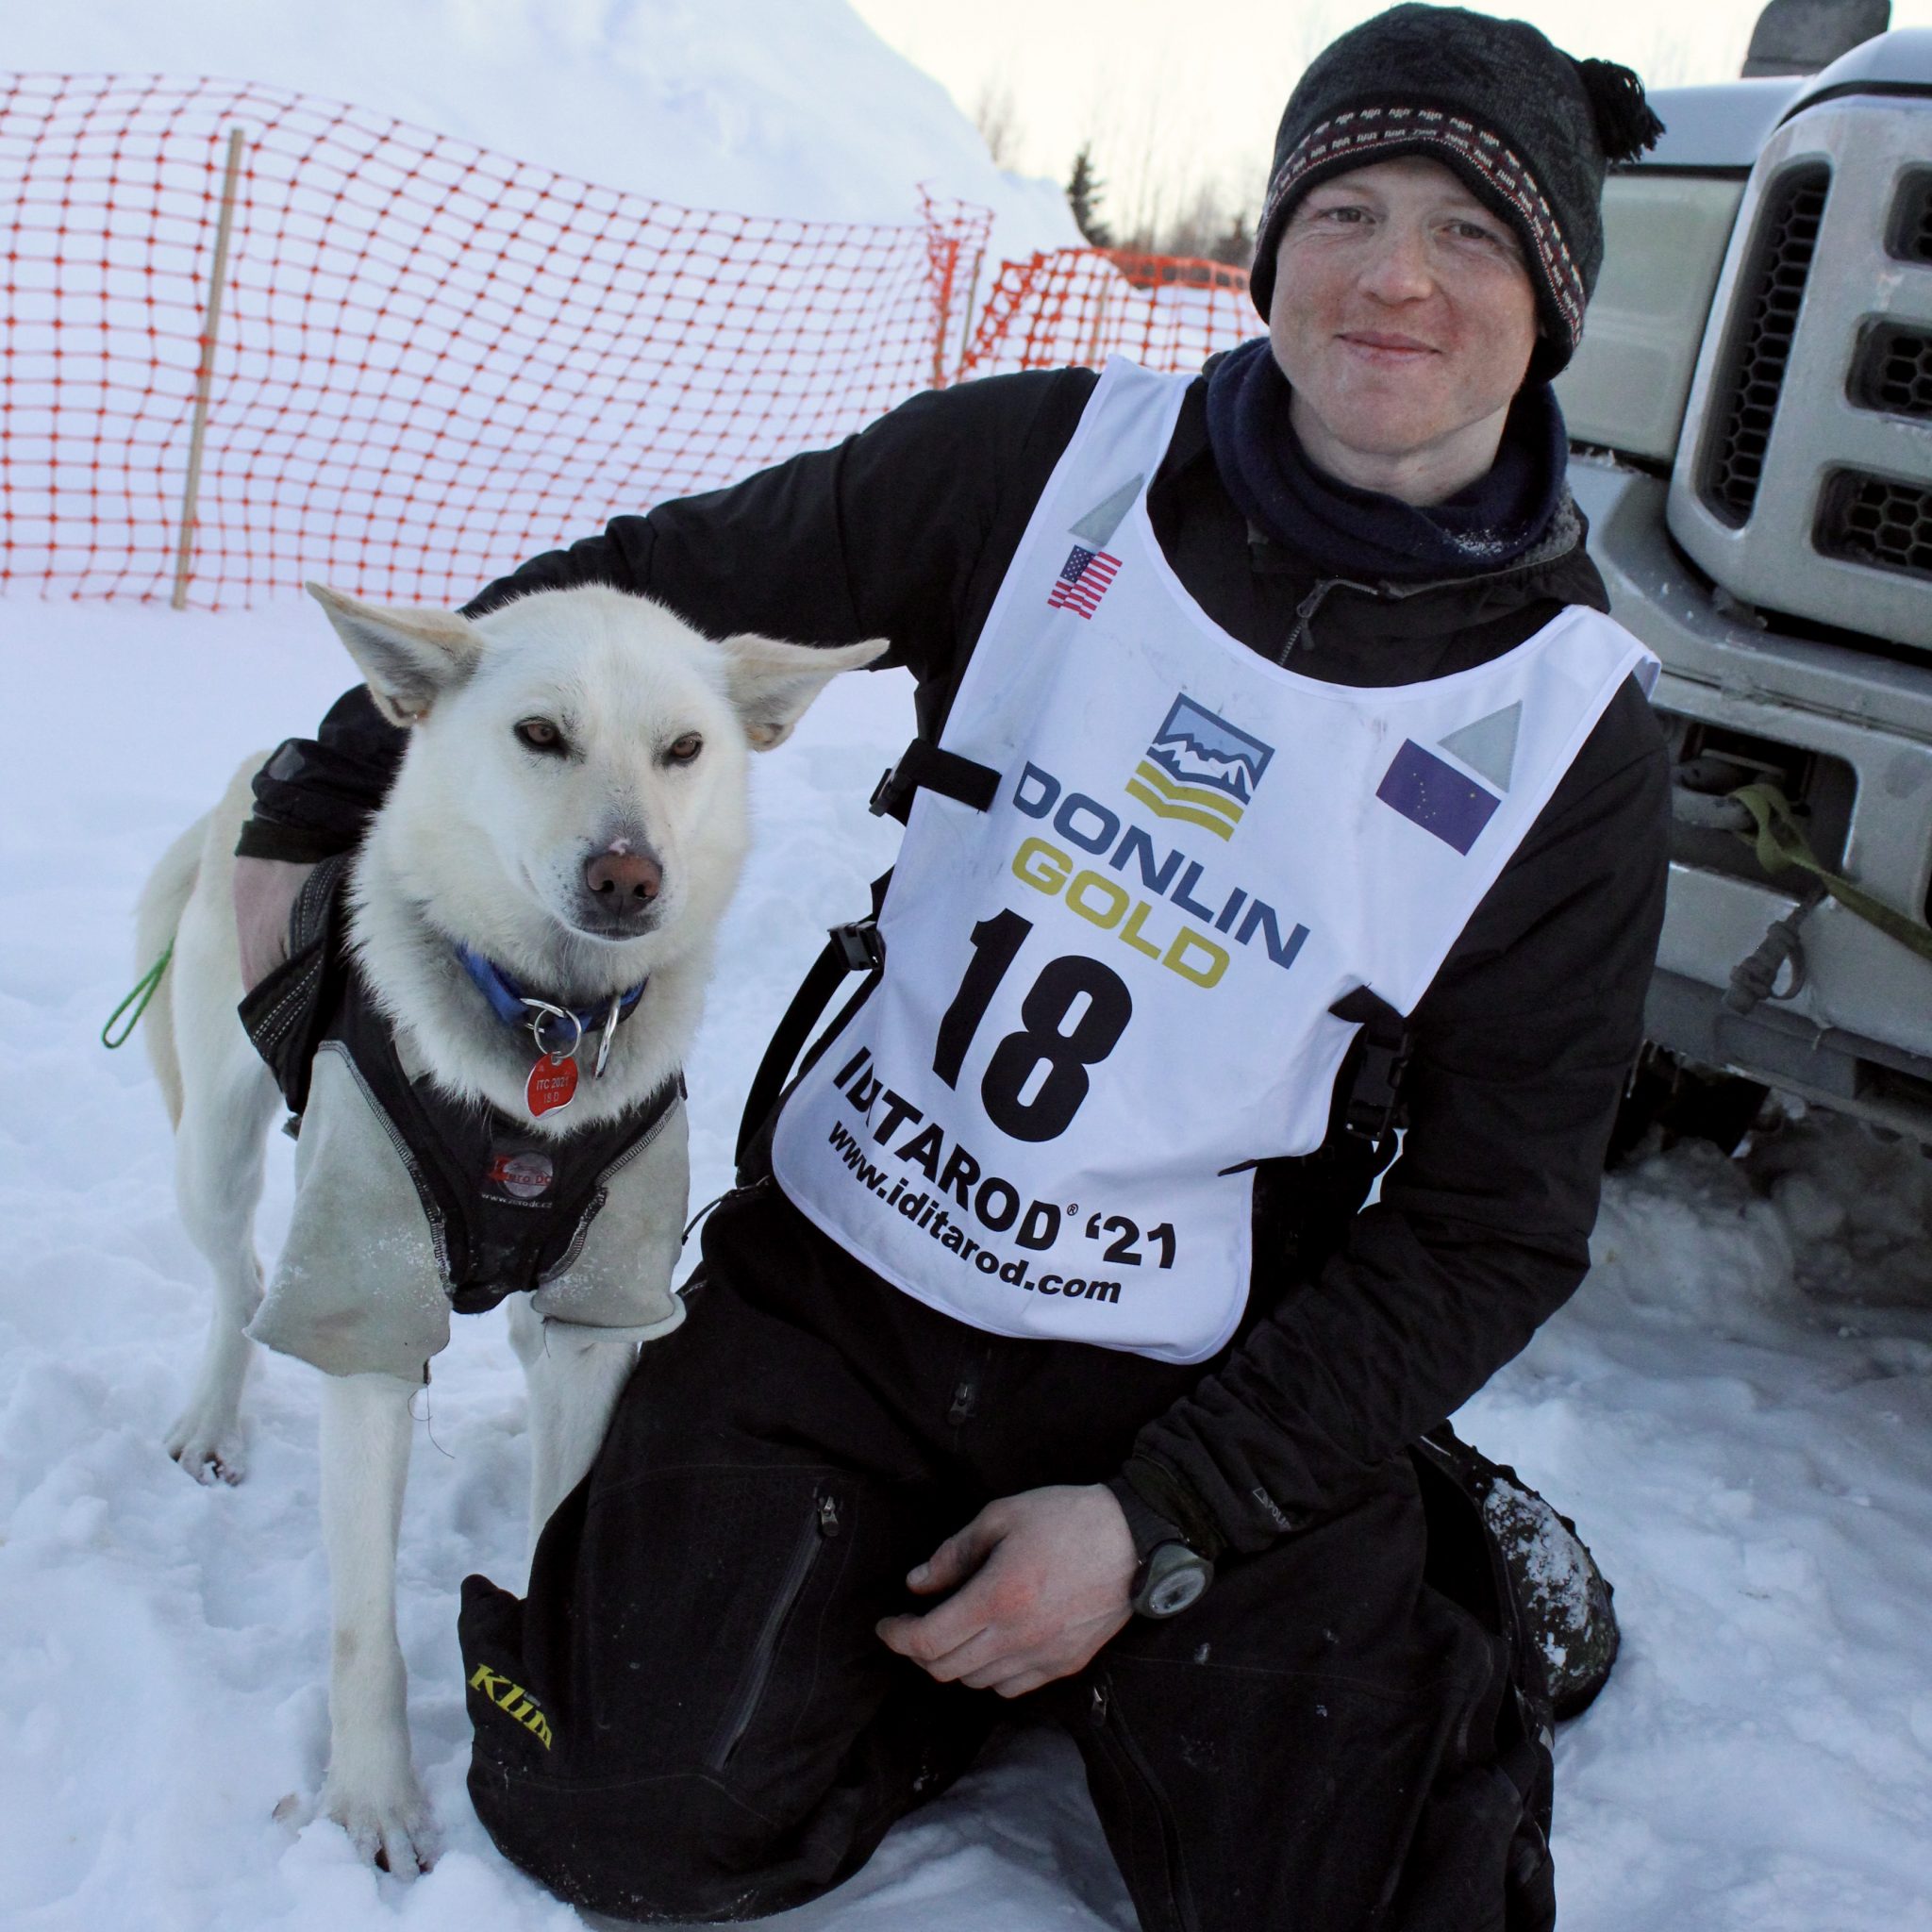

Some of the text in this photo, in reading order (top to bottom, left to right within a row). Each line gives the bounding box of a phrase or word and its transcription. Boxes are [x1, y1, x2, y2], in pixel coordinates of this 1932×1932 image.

[1011, 836, 1230, 989] GOLD
[1012, 759, 1310, 971] DONLIN
[536, 1076, 570, 1091] ITC 2021
[933, 908, 1133, 1142] 18
[827, 1120, 1122, 1304] www.iditarod.com
